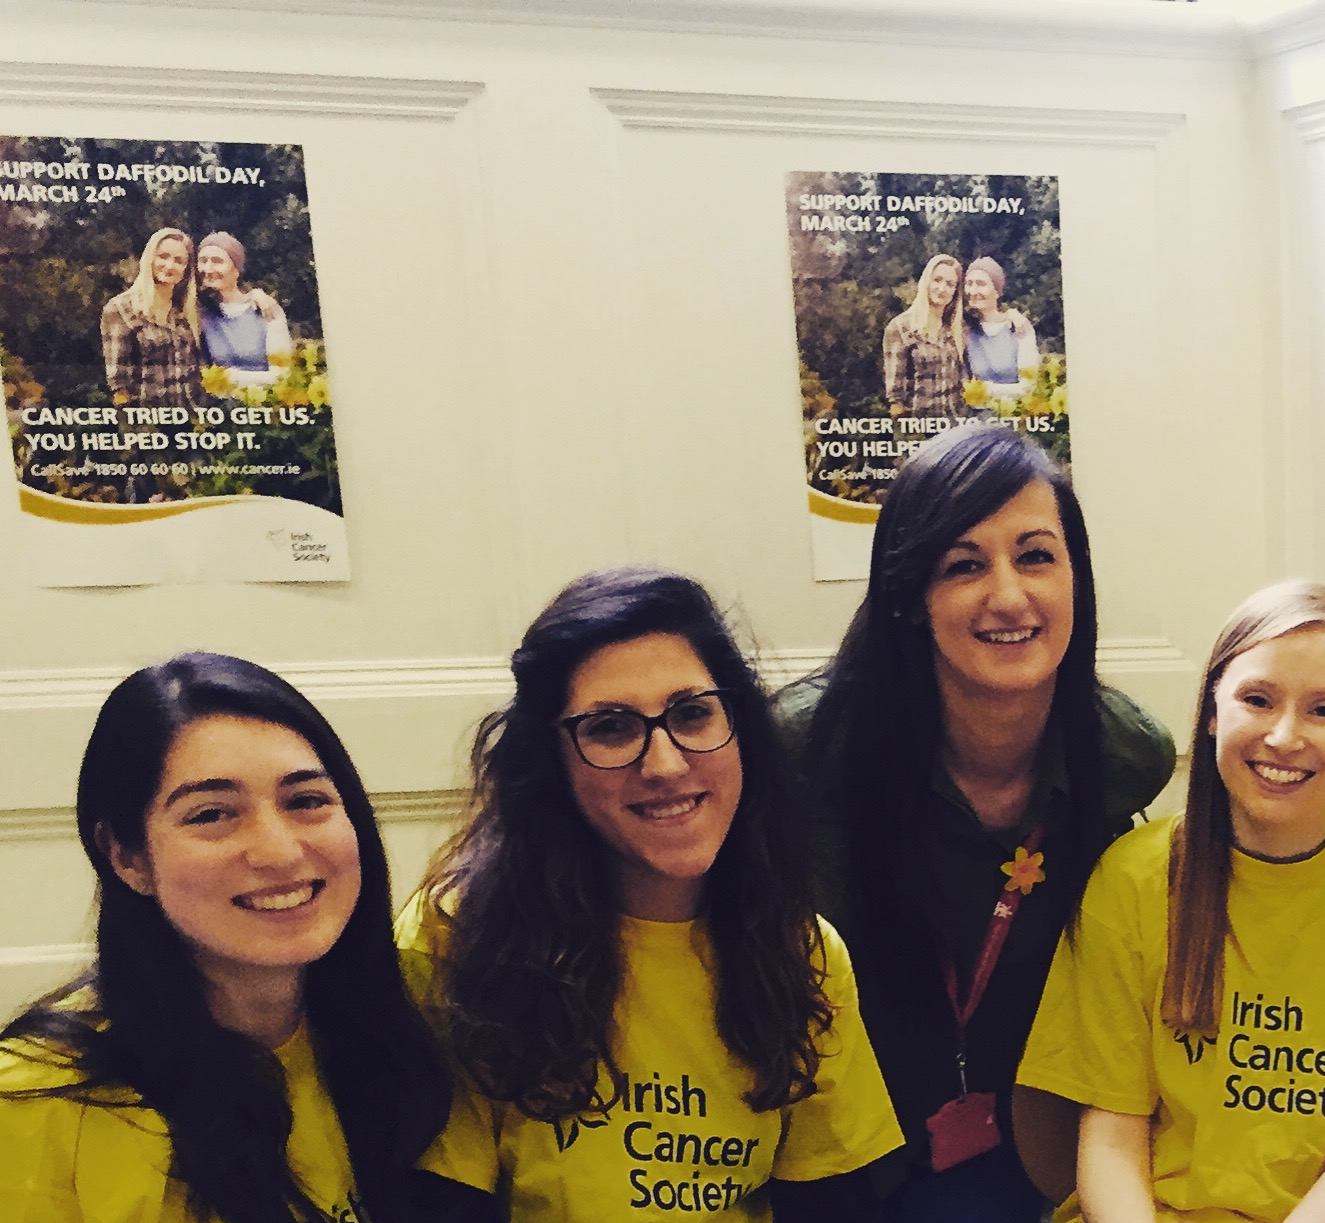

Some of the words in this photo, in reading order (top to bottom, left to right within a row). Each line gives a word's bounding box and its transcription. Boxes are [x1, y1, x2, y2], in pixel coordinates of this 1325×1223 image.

[97, 163, 210, 184] DAFFODIL
[214, 166, 266, 187] DAY,
[0, 183, 79, 202] MARCH
[84, 184, 127, 203] 24th
[800, 194, 882, 212] SUPPORT
[887, 196, 980, 213] DAFFODIL
[983, 197, 1026, 216] DAY,
[801, 215, 871, 232] MARCH
[875, 216, 910, 233] 24th
[22, 407, 118, 426] CANCER
[124, 407, 189, 425] TRIED
[196, 407, 226, 425] TO
[230, 407, 274, 425] GET
[278, 407, 316, 425] US.
[815, 417, 894, 435] CANCER
[899, 417, 951, 434] TRIED
[1026, 416, 1055, 432] US.
[23, 432, 75, 451] YOU
[82, 432, 170, 450] HELPED
[175, 432, 232, 450] STOP
[236, 432, 261, 449] IT.
[817, 440, 857, 458] YOU
[862, 440, 921, 457] HELPE
[95, 463, 128, 477] 1850
[130, 463, 148, 476] 60
[150, 463, 169, 476] 60
[171, 462, 189, 476] 60
[1232, 991, 1304, 1032] Irish
[622, 1071, 707, 1118] Irish
[623, 1120, 760, 1168] Cancer
